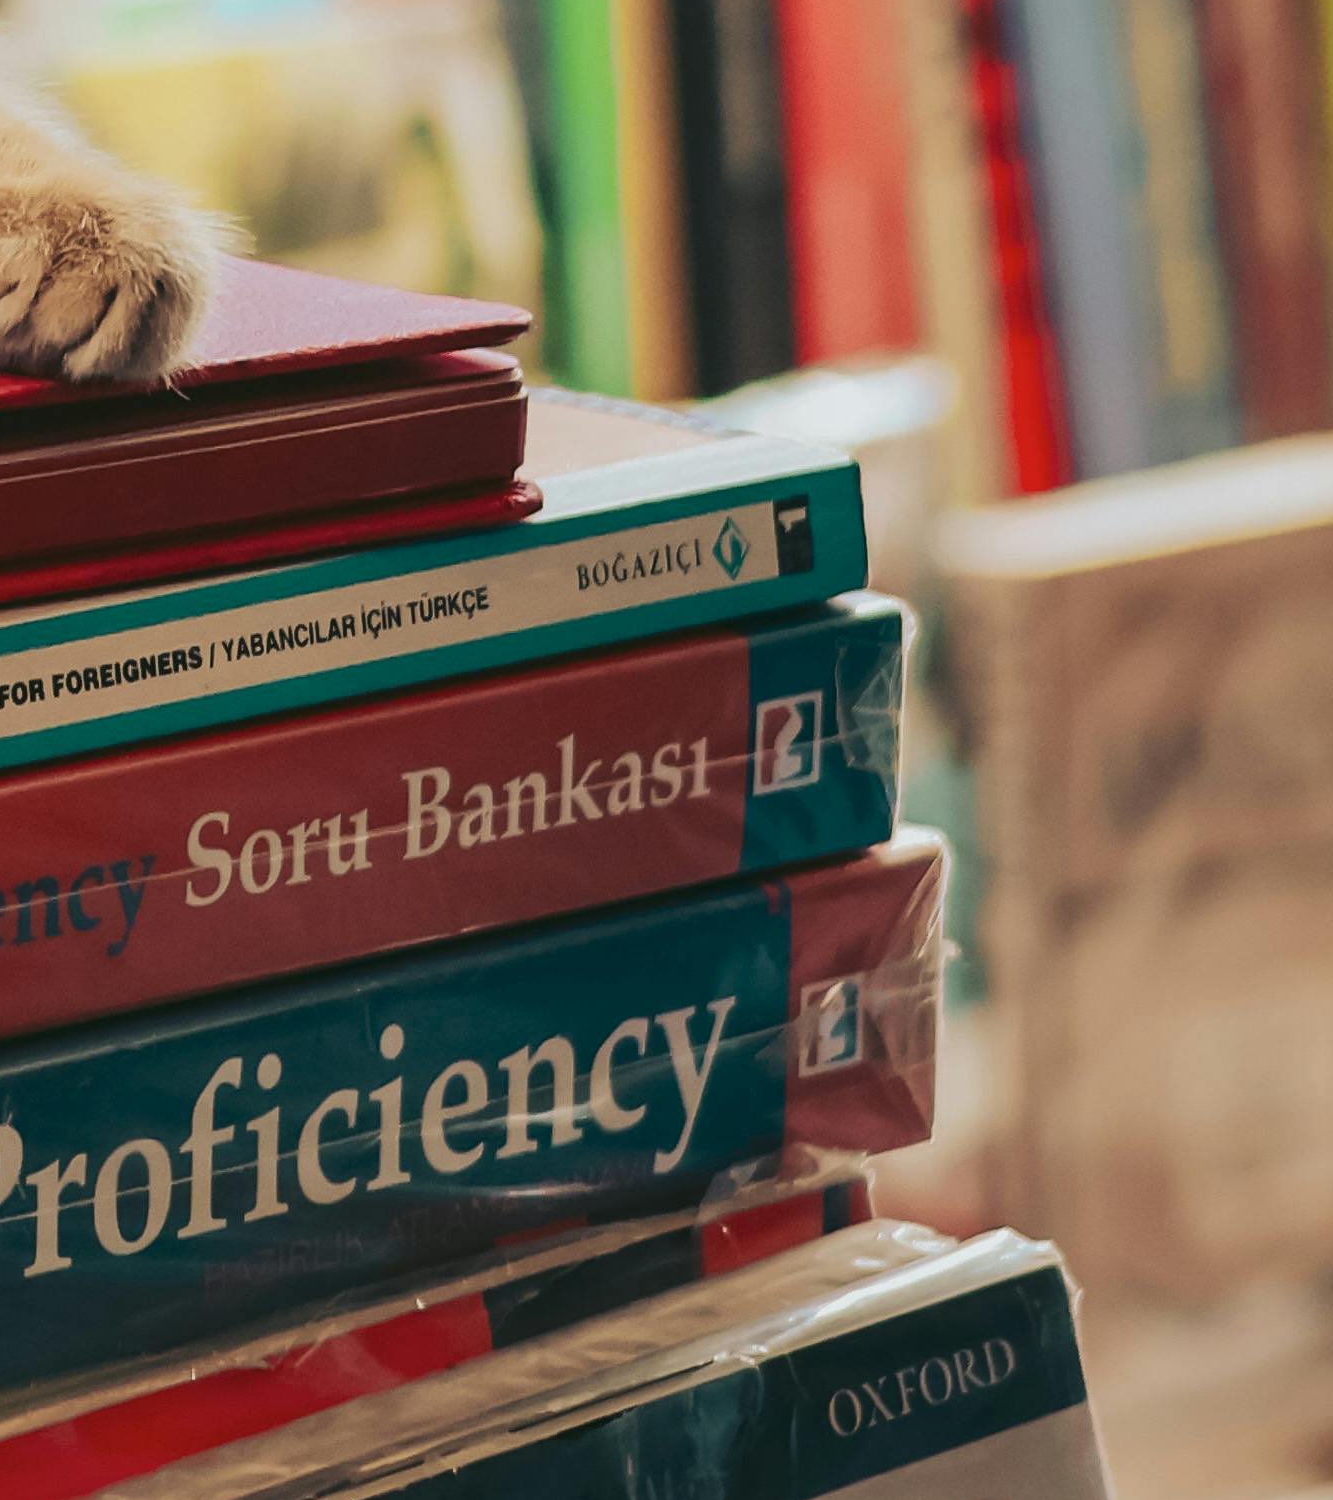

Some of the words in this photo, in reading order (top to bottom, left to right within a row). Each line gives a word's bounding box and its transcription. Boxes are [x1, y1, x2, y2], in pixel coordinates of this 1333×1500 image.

[51, 644, 204, 698] FOREIGNERS
[221, 611, 357, 664] YABANCILAR
[406, 583, 491, 630] TÜRKÇE
[184, 809, 373, 908] Soru
[400, 733, 712, 864] Bankası
[827, 1336, 1018, 1437] OXFORD
